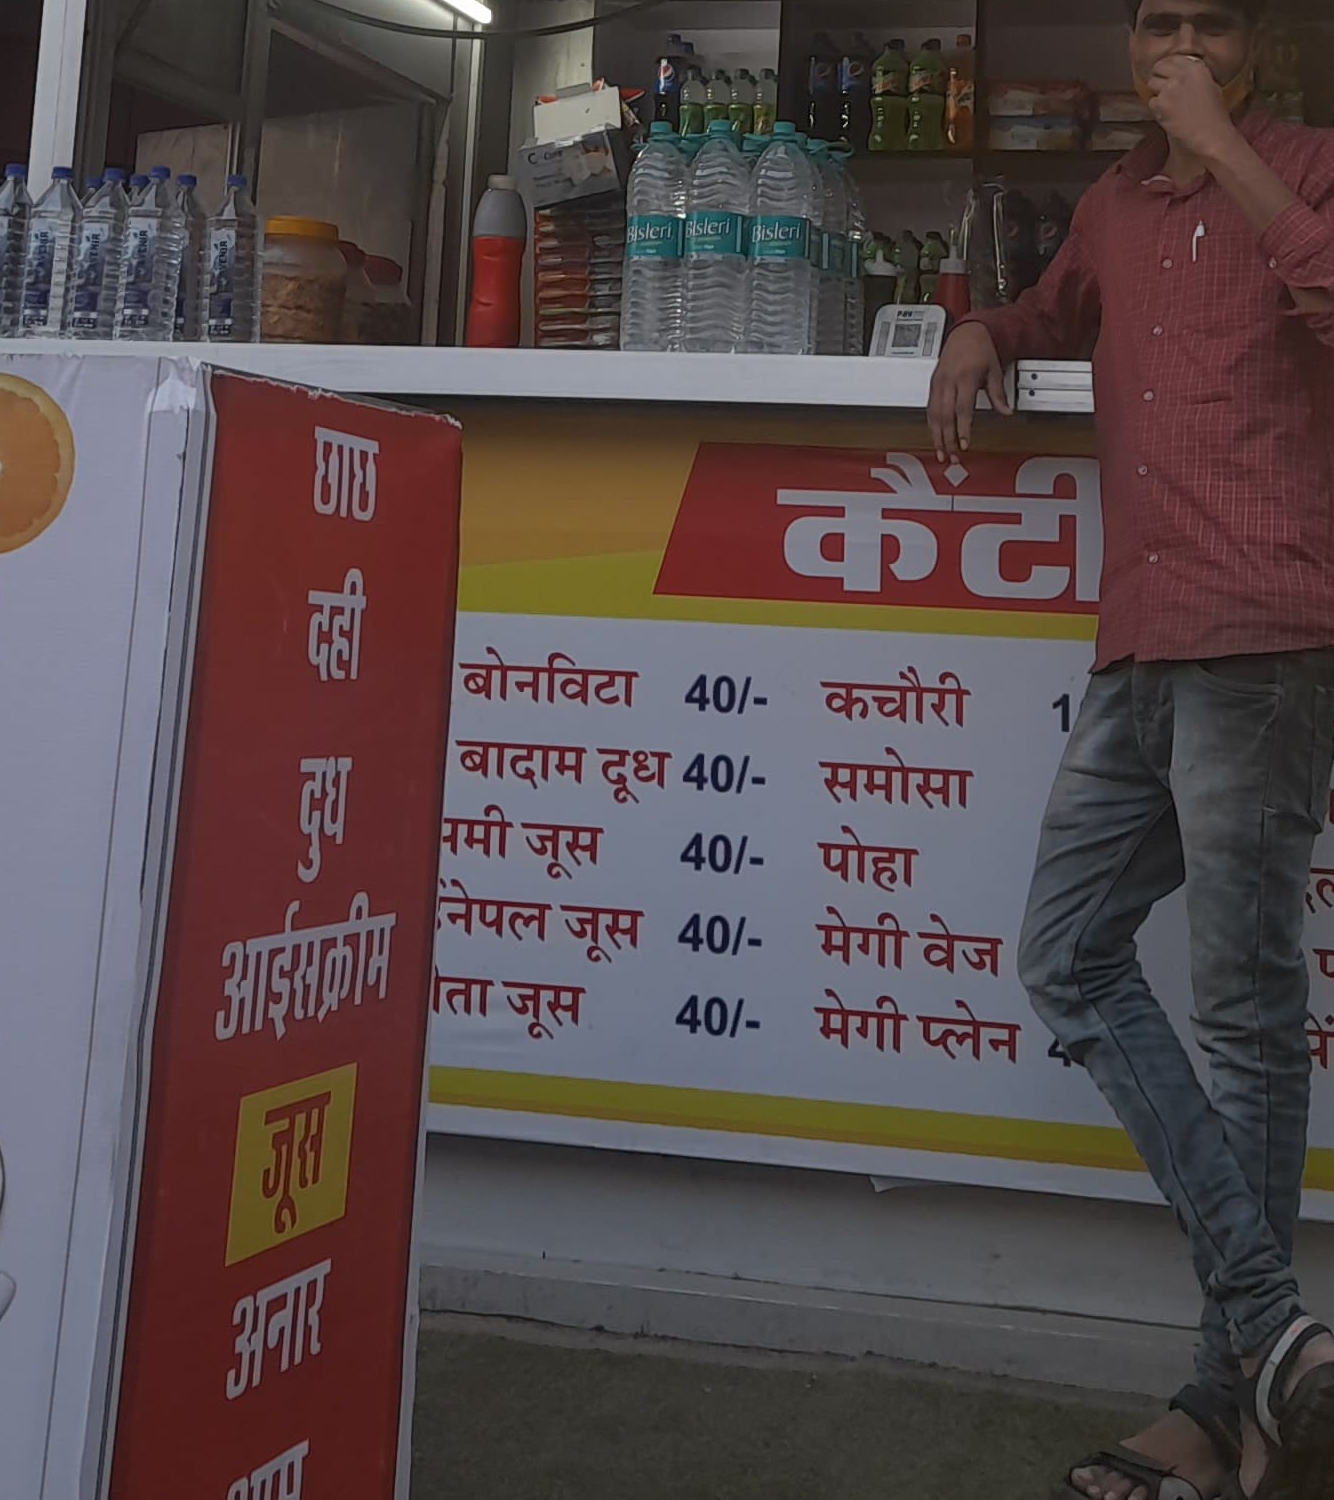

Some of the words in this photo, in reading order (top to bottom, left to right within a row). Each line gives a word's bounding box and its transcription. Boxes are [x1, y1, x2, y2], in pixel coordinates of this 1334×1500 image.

[626, 220, 673, 244] Bisleri
[685, 216, 732, 239] Bisleri
[751, 220, 802, 243] Bisleri
[313, 426, 380, 521] छाछ
[776, 451, 1105, 602] कैंटी
[307, 567, 367, 681] दही
[458, 646, 640, 708] बोनविटा
[684, 674, 769, 715] 40/-
[819, 665, 971, 728] कचौरी
[455, 739, 587, 790] बादाम
[596, 745, 673, 804] दूध
[681, 751, 767, 794] 40/-
[817, 745, 975, 809] समोसा
[521, 821, 604, 880] जूस
[679, 833, 765, 875] 40/-
[816, 825, 919, 893] पोहा
[439, 878, 552, 941] नेपल
[560, 903, 645, 964] जूस
[677, 913, 763, 956] 40/-
[815, 905, 910, 970] मेगी
[917, 913, 1004, 978] वेज
[213, 891, 397, 1042] आईसक्रीम
[502, 978, 587, 1041] जूस
[675, 994, 761, 1038] 40/-
[814, 988, 910, 1054] मेगी
[916, 999, 1022, 1064] प्लेन
[260, 1090, 332, 1236] जूस
[226, 1258, 332, 1401] अनार
